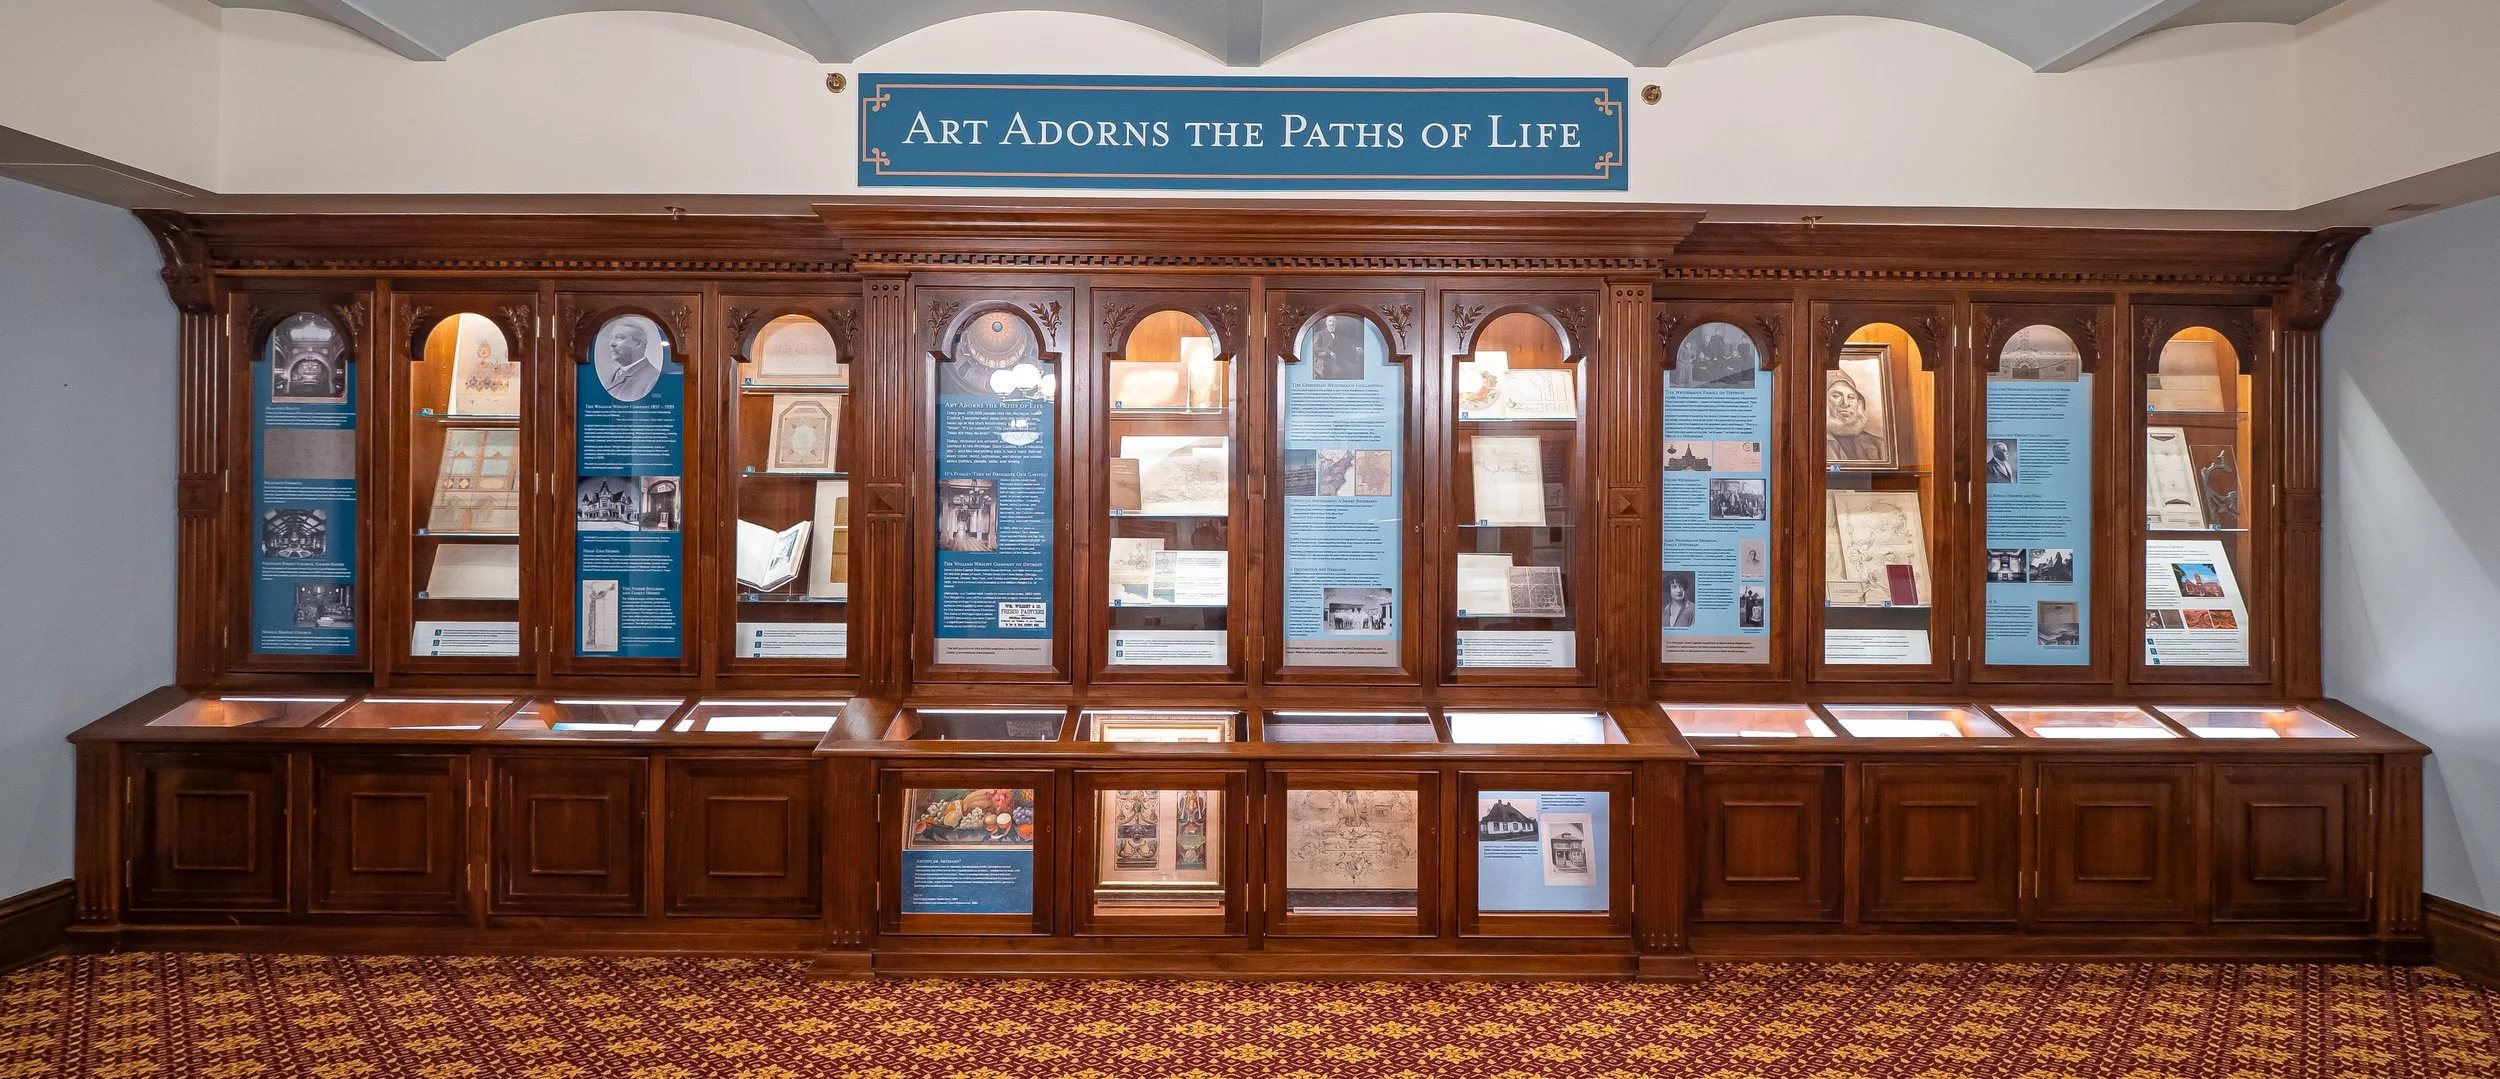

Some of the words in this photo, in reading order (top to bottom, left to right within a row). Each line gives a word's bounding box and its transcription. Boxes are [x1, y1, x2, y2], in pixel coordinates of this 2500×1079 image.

[902, 111, 988, 144] ART
[999, 112, 1169, 146] ADORNS
[1185, 123, 1263, 146] THE
[1281, 115, 1403, 148] PATHS
[1422, 123, 1471, 148] OF
[1488, 115, 1580, 147] LIFE
